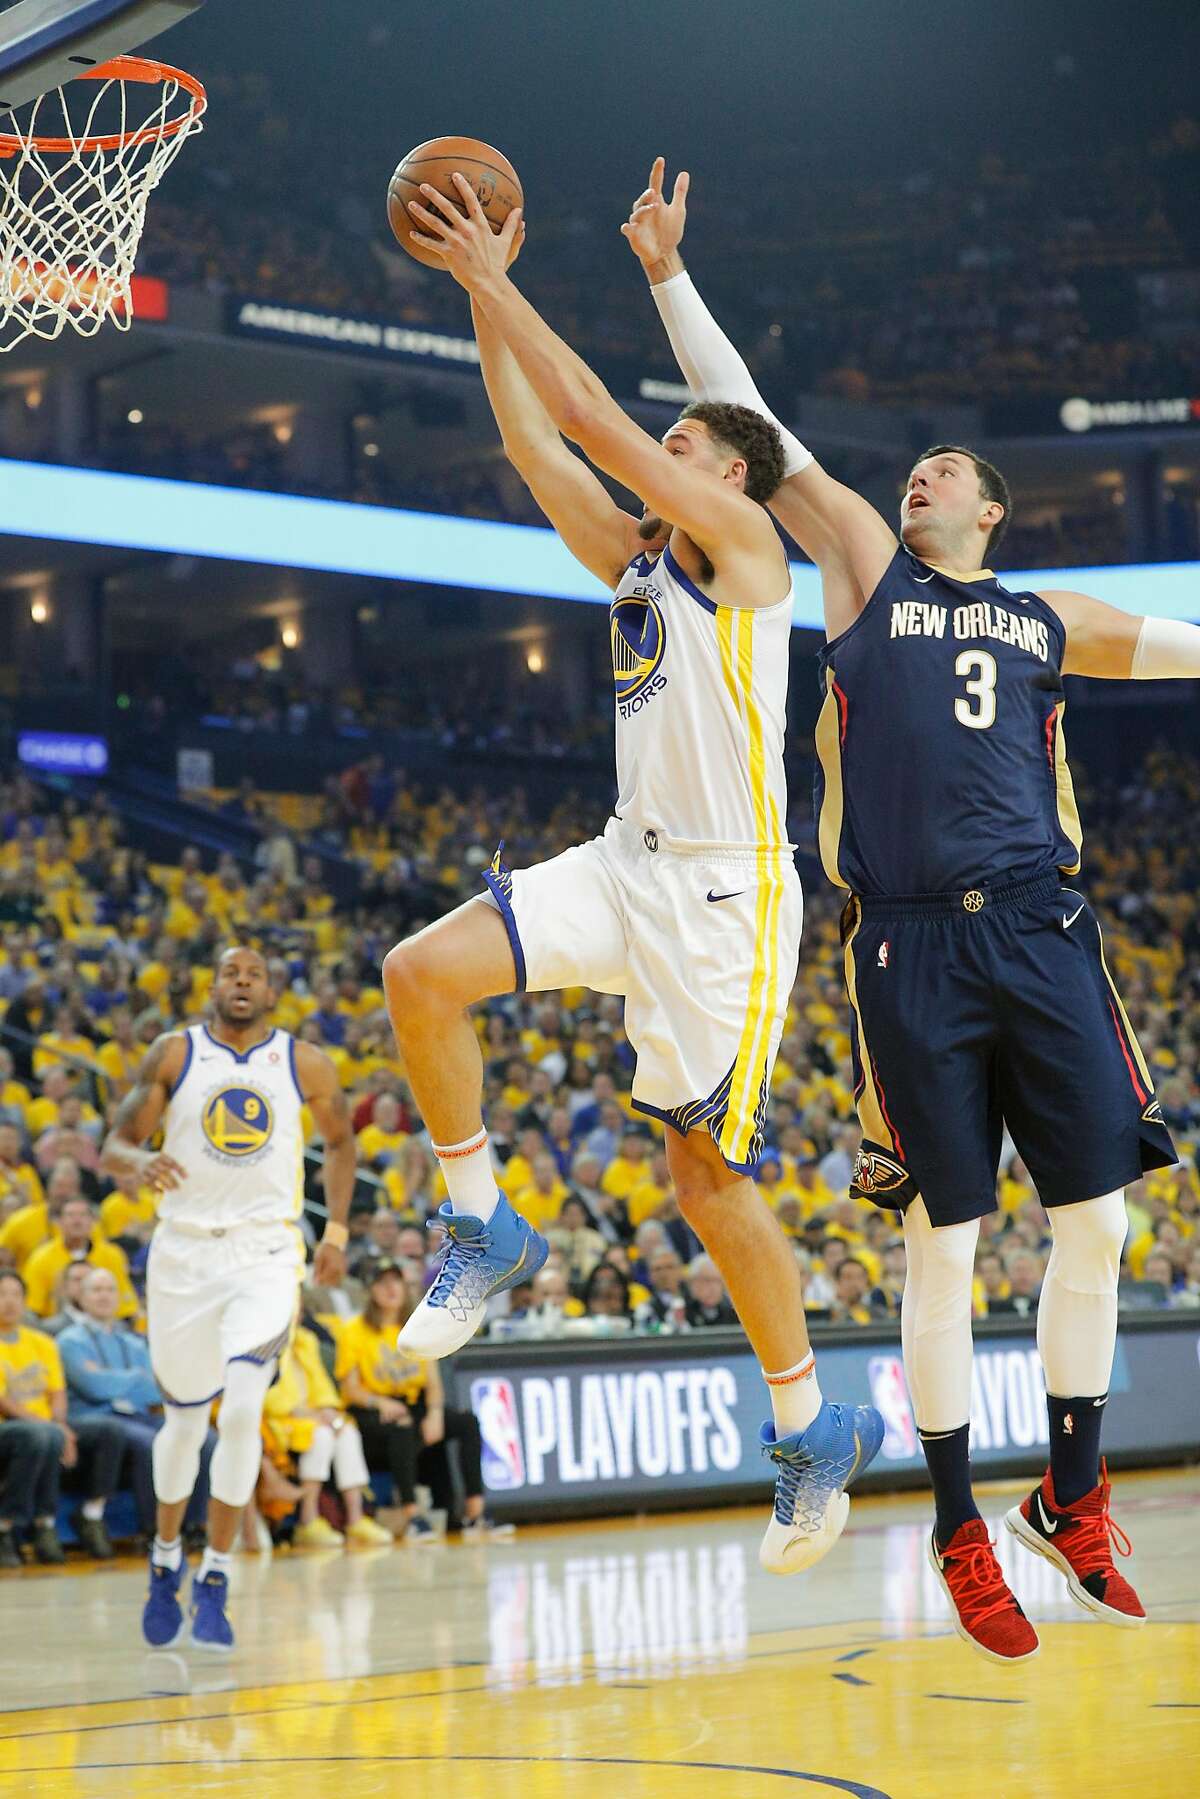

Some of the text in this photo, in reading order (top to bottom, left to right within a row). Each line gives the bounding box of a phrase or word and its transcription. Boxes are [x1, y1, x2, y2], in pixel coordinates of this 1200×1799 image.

[239, 303, 481, 364] AMERICAN EXPRES
[890, 601, 1049, 663] NEW ORLEANS
[619, 674, 668, 720] RIORS
[954, 649, 998, 730] 3
[244, 1097, 260, 1121] 9
[521, 1367, 742, 1485] PLAYOFFS
